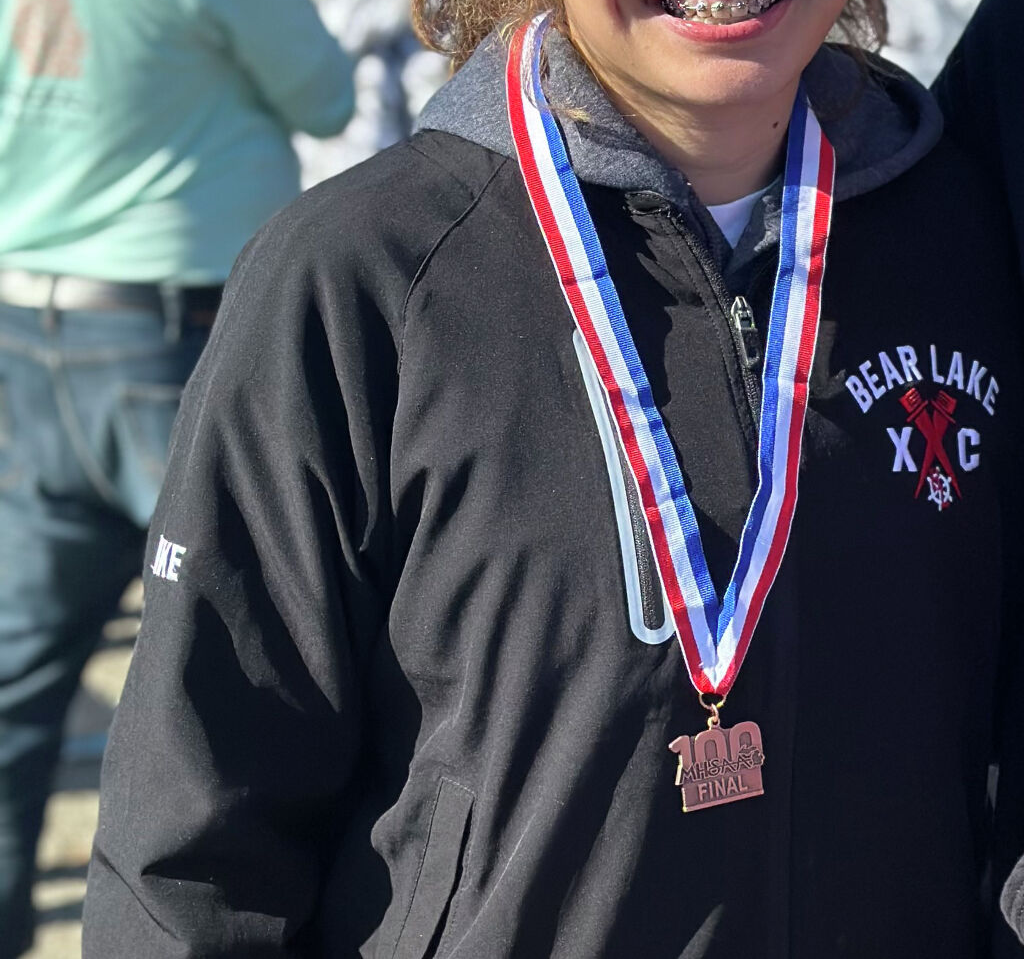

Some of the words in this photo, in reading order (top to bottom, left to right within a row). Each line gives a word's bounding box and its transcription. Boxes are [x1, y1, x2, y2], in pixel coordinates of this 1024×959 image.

[845, 345, 923, 413] BEAR
[930, 344, 999, 416] LAKE
[886, 427, 917, 472] X
[957, 428, 980, 471] C
[668, 721, 763, 769] 100
[677, 754, 755, 784] MHSAA
[697, 775, 748, 802] FINAL
